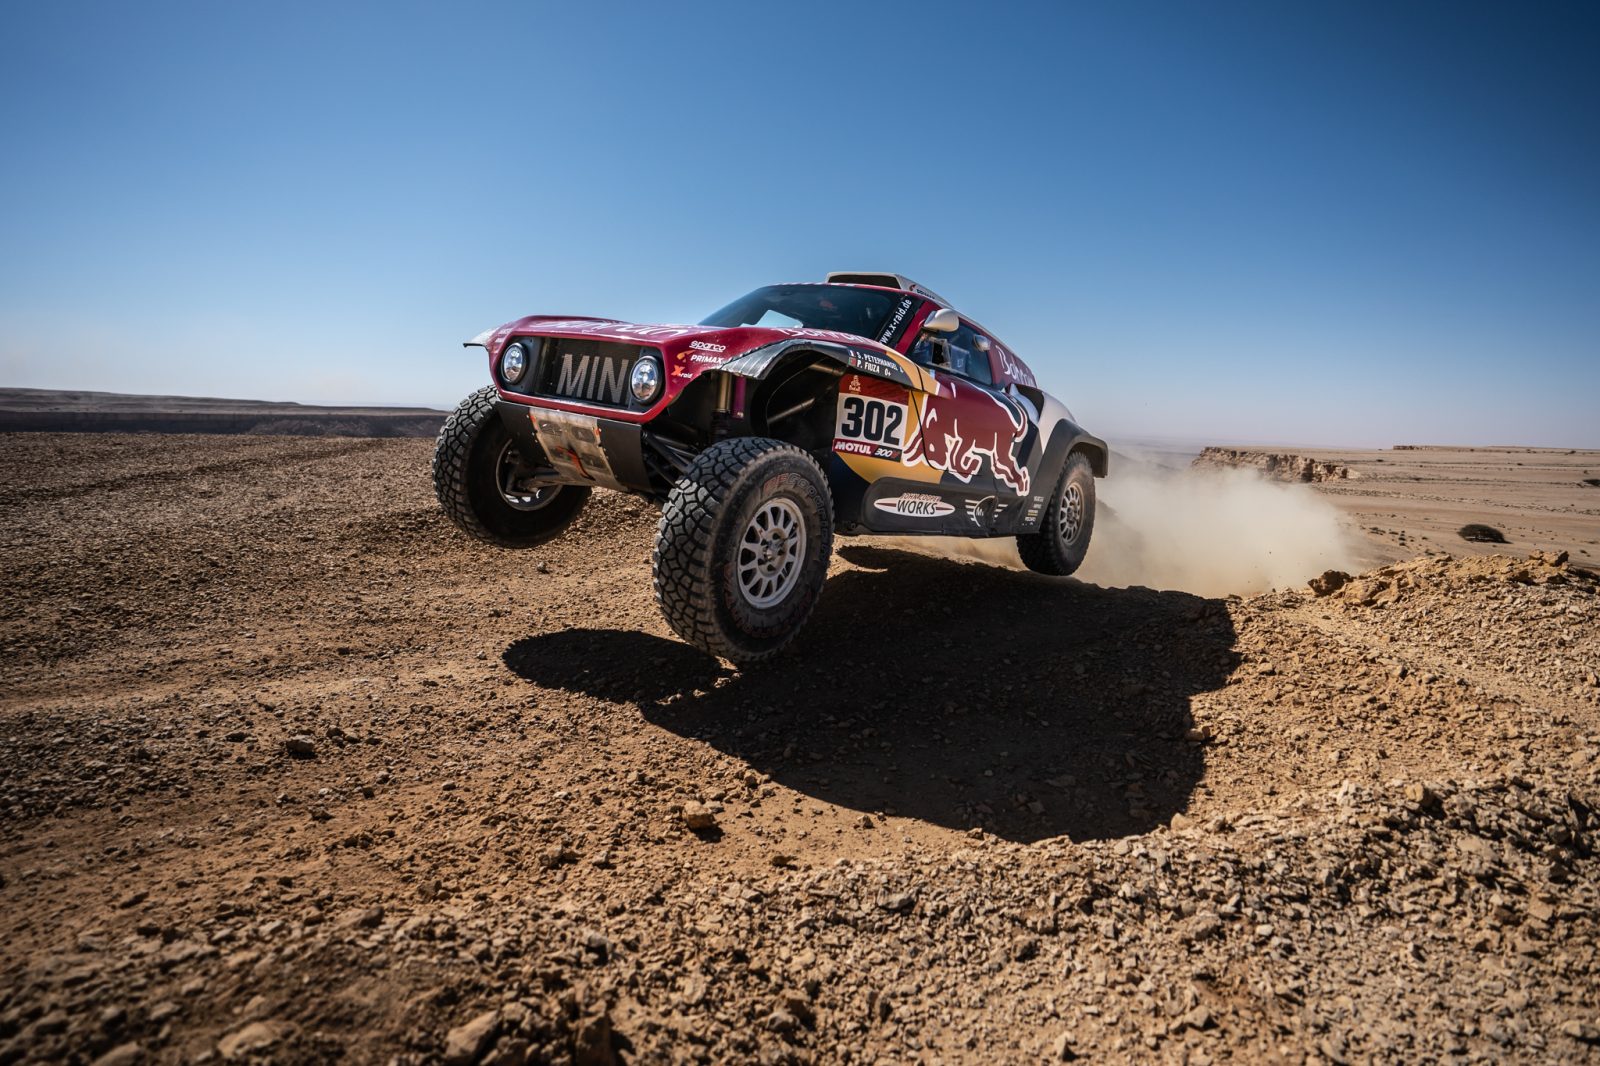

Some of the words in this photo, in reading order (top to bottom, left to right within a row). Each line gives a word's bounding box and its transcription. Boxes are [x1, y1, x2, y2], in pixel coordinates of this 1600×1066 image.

[879, 299, 912, 344] ww.x-raid.de
[688, 340, 727, 352] sparco
[690, 354, 724, 364] PRIMAX
[864, 361, 880, 373] FIUZA
[556, 353, 629, 406] MIN
[841, 396, 903, 446] 302
[834, 441, 872, 455] MOTUL
[896, 500, 937, 515] WORKS
